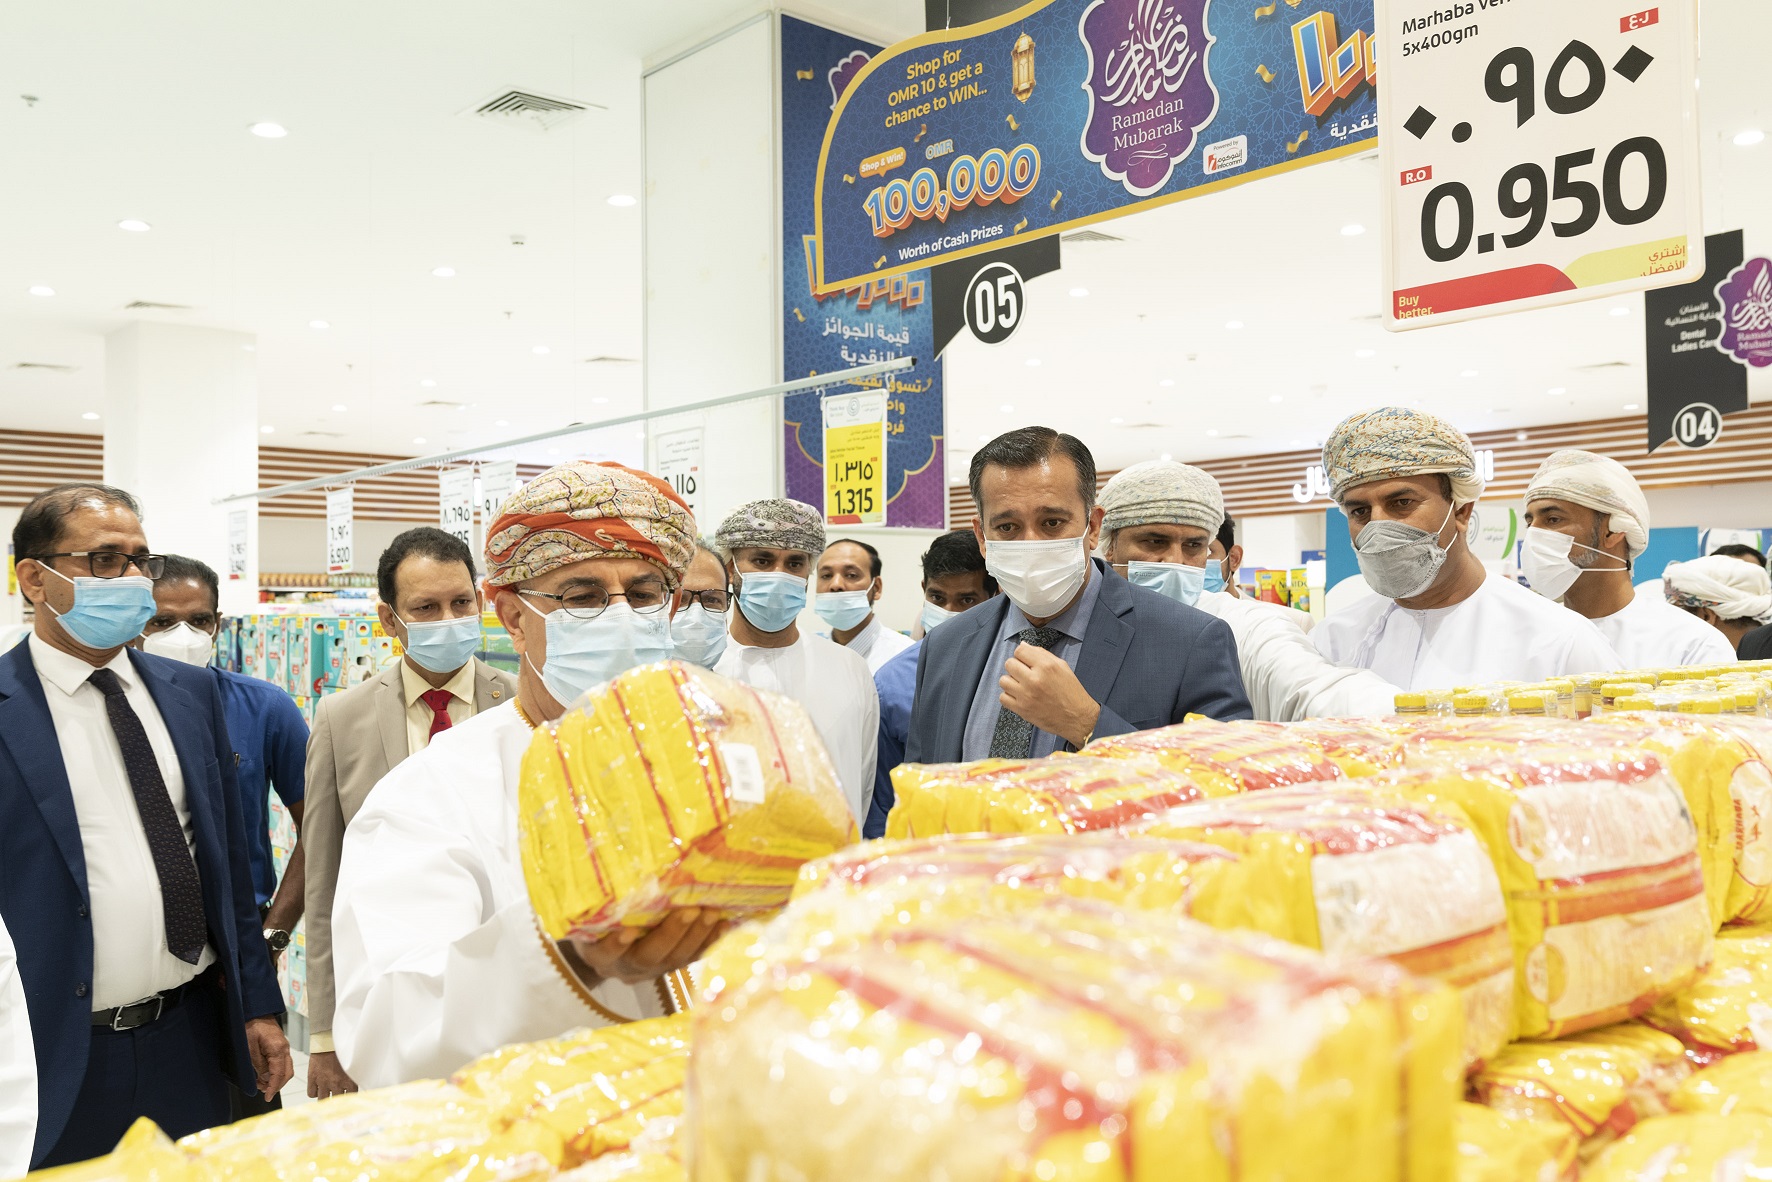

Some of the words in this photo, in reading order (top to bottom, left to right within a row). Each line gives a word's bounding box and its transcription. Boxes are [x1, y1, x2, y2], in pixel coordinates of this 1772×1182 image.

[1402, 2, 1474, 35] Marhaba
[1402, 22, 1479, 57] 5x400gm
[906, 55, 941, 80] Shop
[942, 48, 963, 68] for
[887, 84, 919, 107] OMR
[920, 77, 936, 95] 10
[938, 73, 948, 89] &
[949, 63, 972, 87] get
[973, 61, 983, 75] a
[884, 102, 931, 128] chance
[932, 96, 947, 112] to
[948, 81, 988, 106] WIN...
[1111, 98, 1184, 131] Ramadan
[925, 138, 954, 161] OMR
[1113, 117, 1183, 152] Mubarak
[1213, 142, 1232, 151] Powered
[861, 158, 880, 173] Shop
[880, 157, 886, 167] &
[886, 151, 904, 165] Win!
[1405, 169, 1427, 184] R.O
[862, 143, 1042, 238] 100,000
[1420, 135, 1668, 263] 0.950
[898, 241, 930, 260] Worth
[931, 237, 943, 252] of
[943, 232, 969, 250] Cash
[970, 223, 1004, 242] Prizes
[974, 273, 1018, 334] 05
[1398, 294, 1420, 308] Buy
[1398, 305, 1435, 320] better.
[822, 316, 875, 341] الجوائز
[877, 325, 910, 347] قيمة
[1680, 327, 1707, 341] Dental
[1671, 341, 1698, 353] Ladies
[1680, 410, 1715, 444] 04
[834, 487, 873, 515] 1.315
